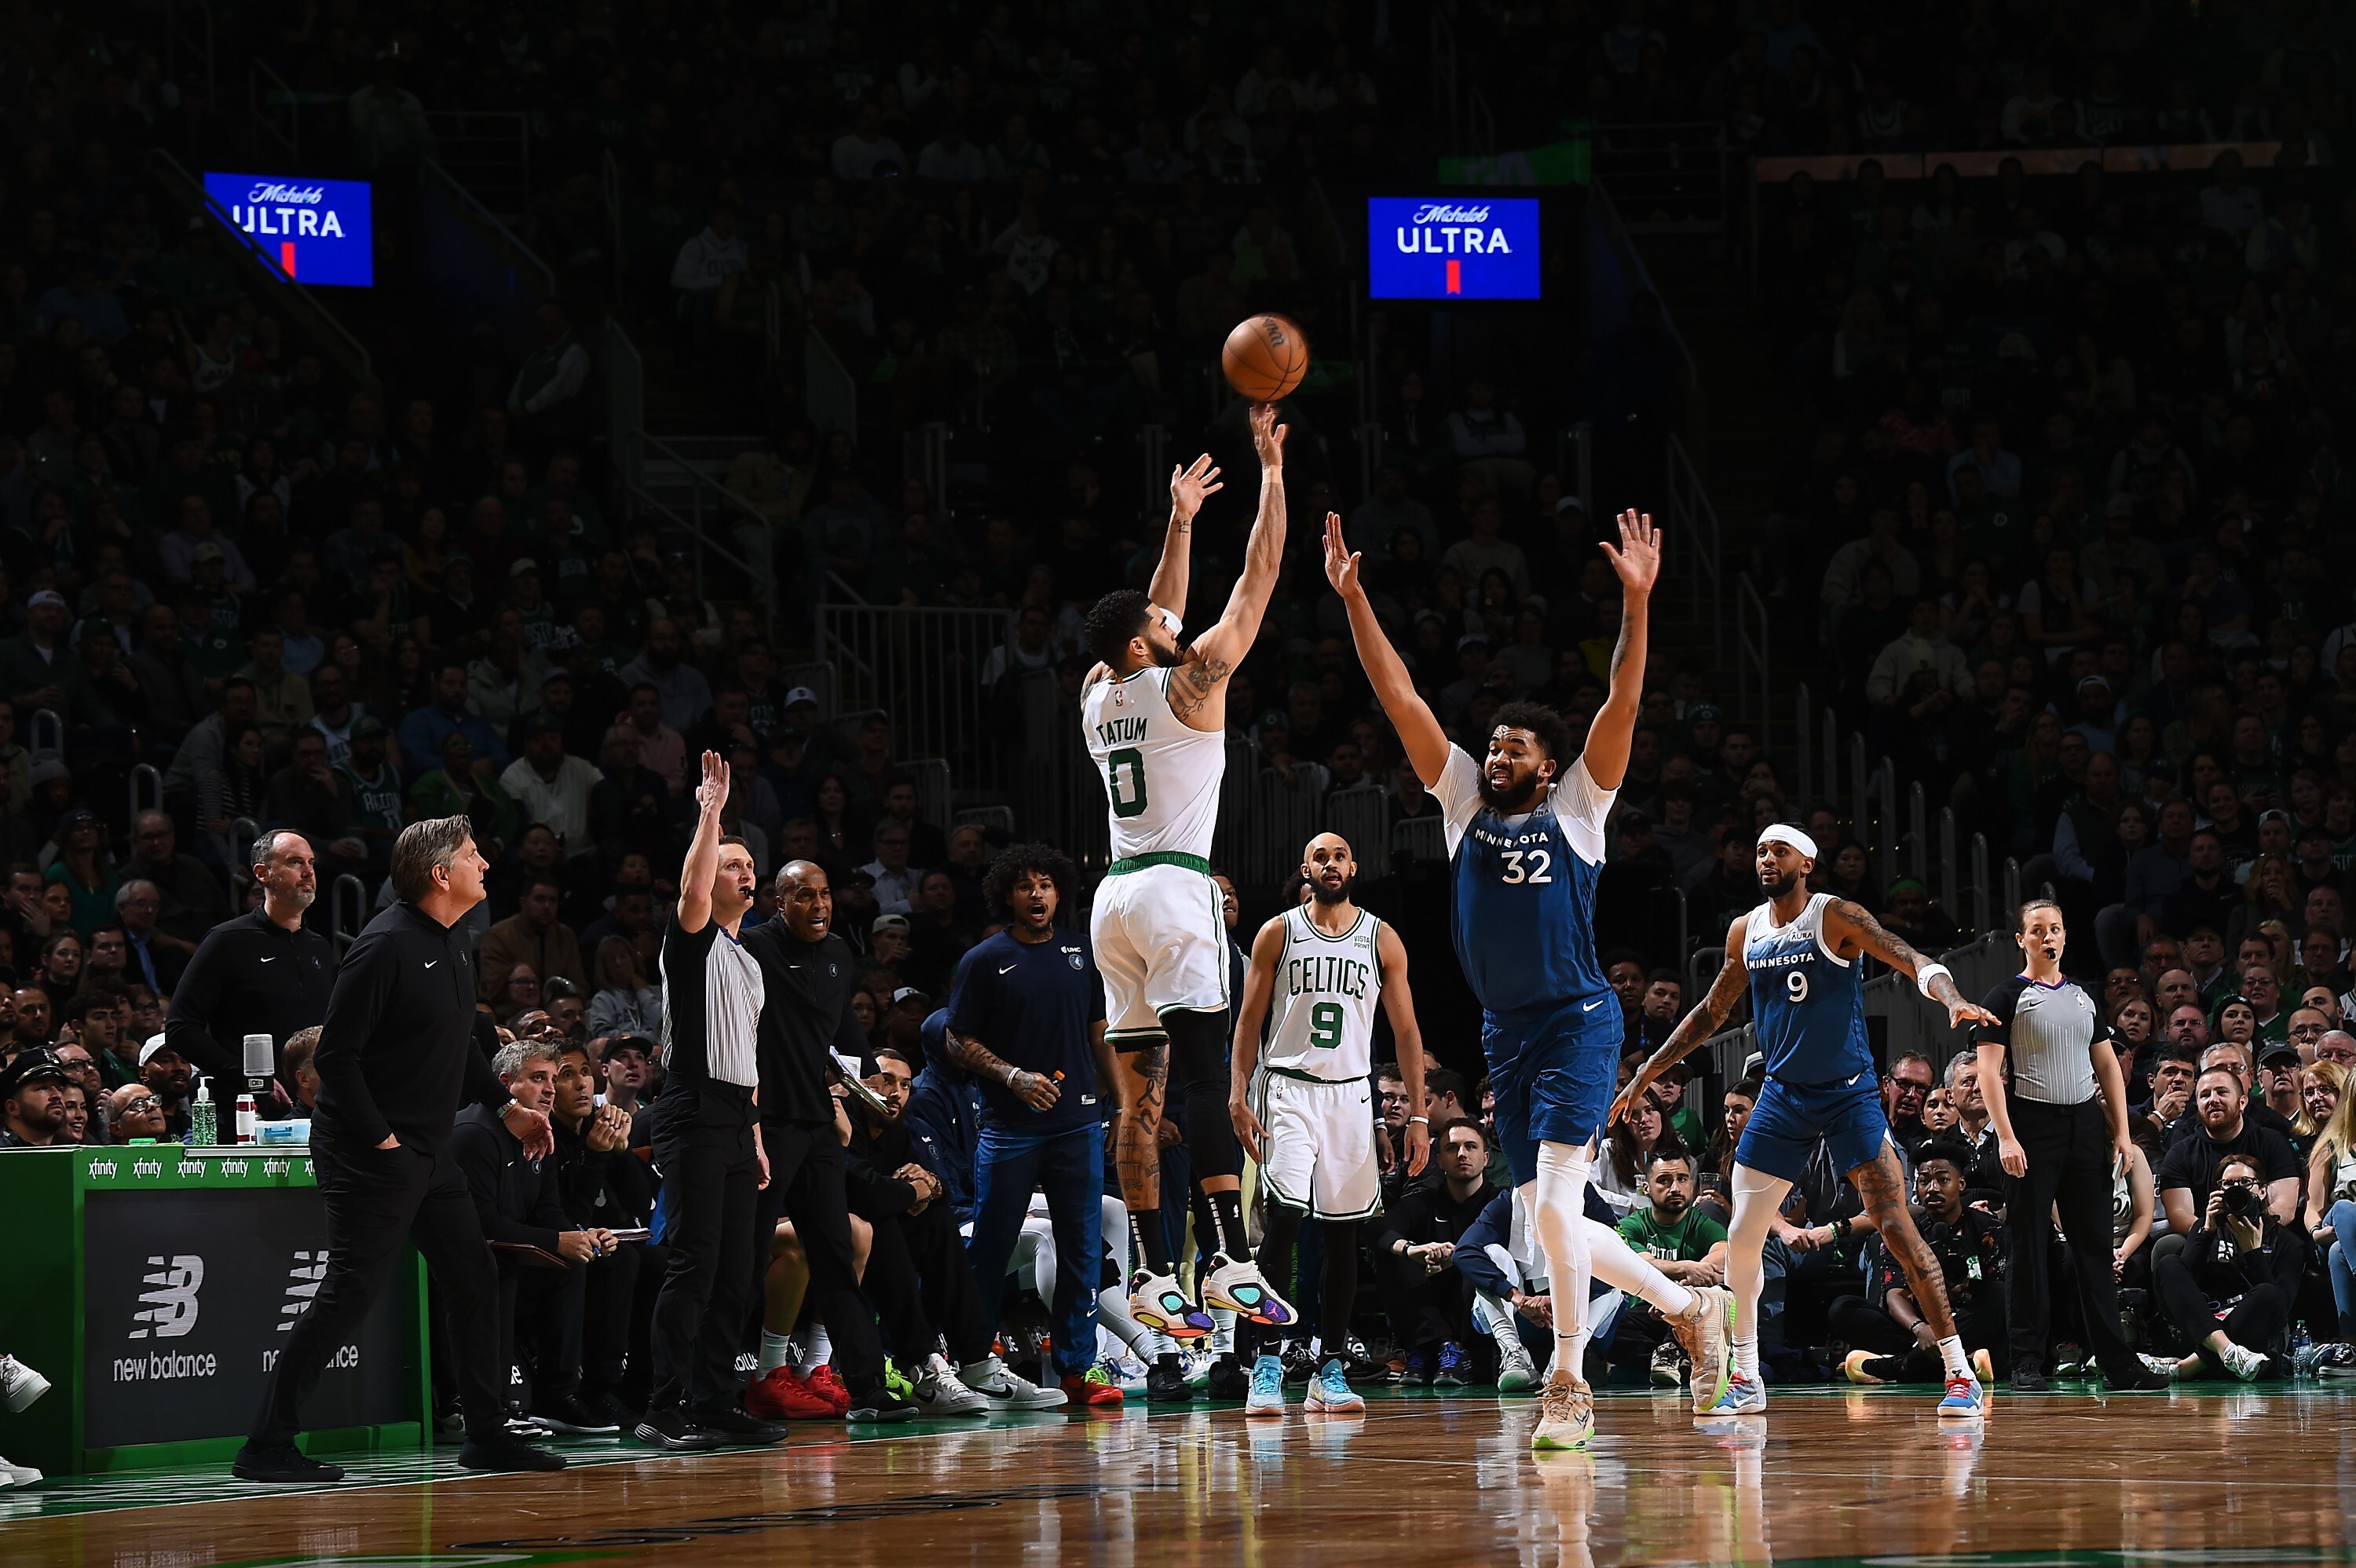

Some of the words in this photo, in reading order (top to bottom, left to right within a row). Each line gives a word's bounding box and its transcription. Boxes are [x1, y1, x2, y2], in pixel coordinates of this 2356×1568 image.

[248, 182, 324, 204] Michelob
[232, 205, 343, 237] ULTRA
[1413, 204, 1491, 224] Michelob
[1397, 227, 1510, 254] ULTRA
[1096, 717, 1148, 747] TATUM
[1108, 747, 1148, 818] 0
[1501, 849, 1552, 884] 32
[1748, 952, 1815, 970] MINNESOTA
[1289, 956, 1369, 1000] CELTICS
[1787, 971, 1809, 1003] 9
[1310, 1002, 1344, 1049] 9
[89, 1157, 118, 1179] xfinity
[133, 1157, 163, 1179] xfinity
[177, 1157, 207, 1179] xfinity
[221, 1157, 249, 1178] xfinity
[263, 1157, 291, 1178] xfinity
[113, 1358, 148, 1382] new
[150, 1350, 217, 1380] balance
